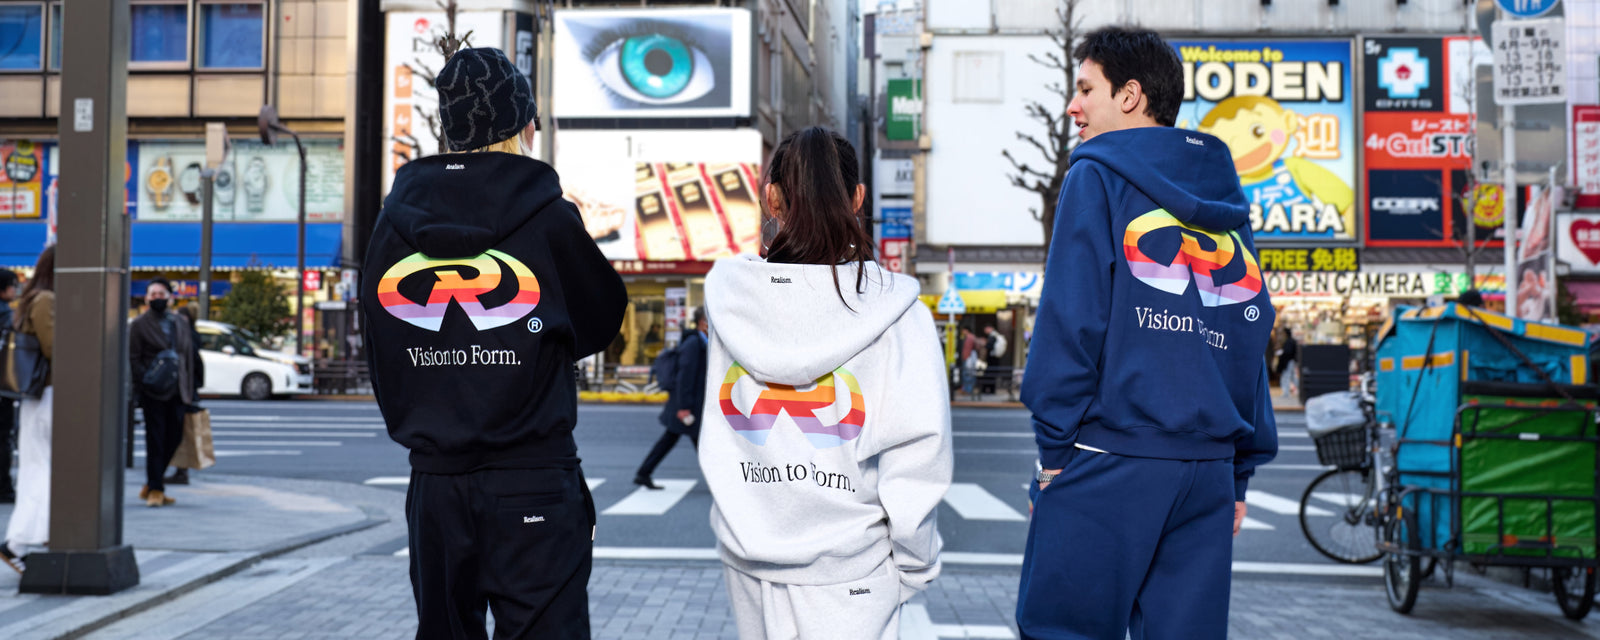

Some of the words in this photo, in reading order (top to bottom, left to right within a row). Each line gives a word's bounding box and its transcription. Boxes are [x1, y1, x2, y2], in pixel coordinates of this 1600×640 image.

[1180, 46, 1255, 63] Welcome
[1256, 47, 1284, 63] to
[1259, 249, 1309, 271] FREE
[1333, 272, 1426, 295] CAMERA
[1135, 306, 1194, 333] Vision
[470, 344, 521, 366] Form.
[740, 461, 782, 484] Vision
[785, 463, 807, 482] to
